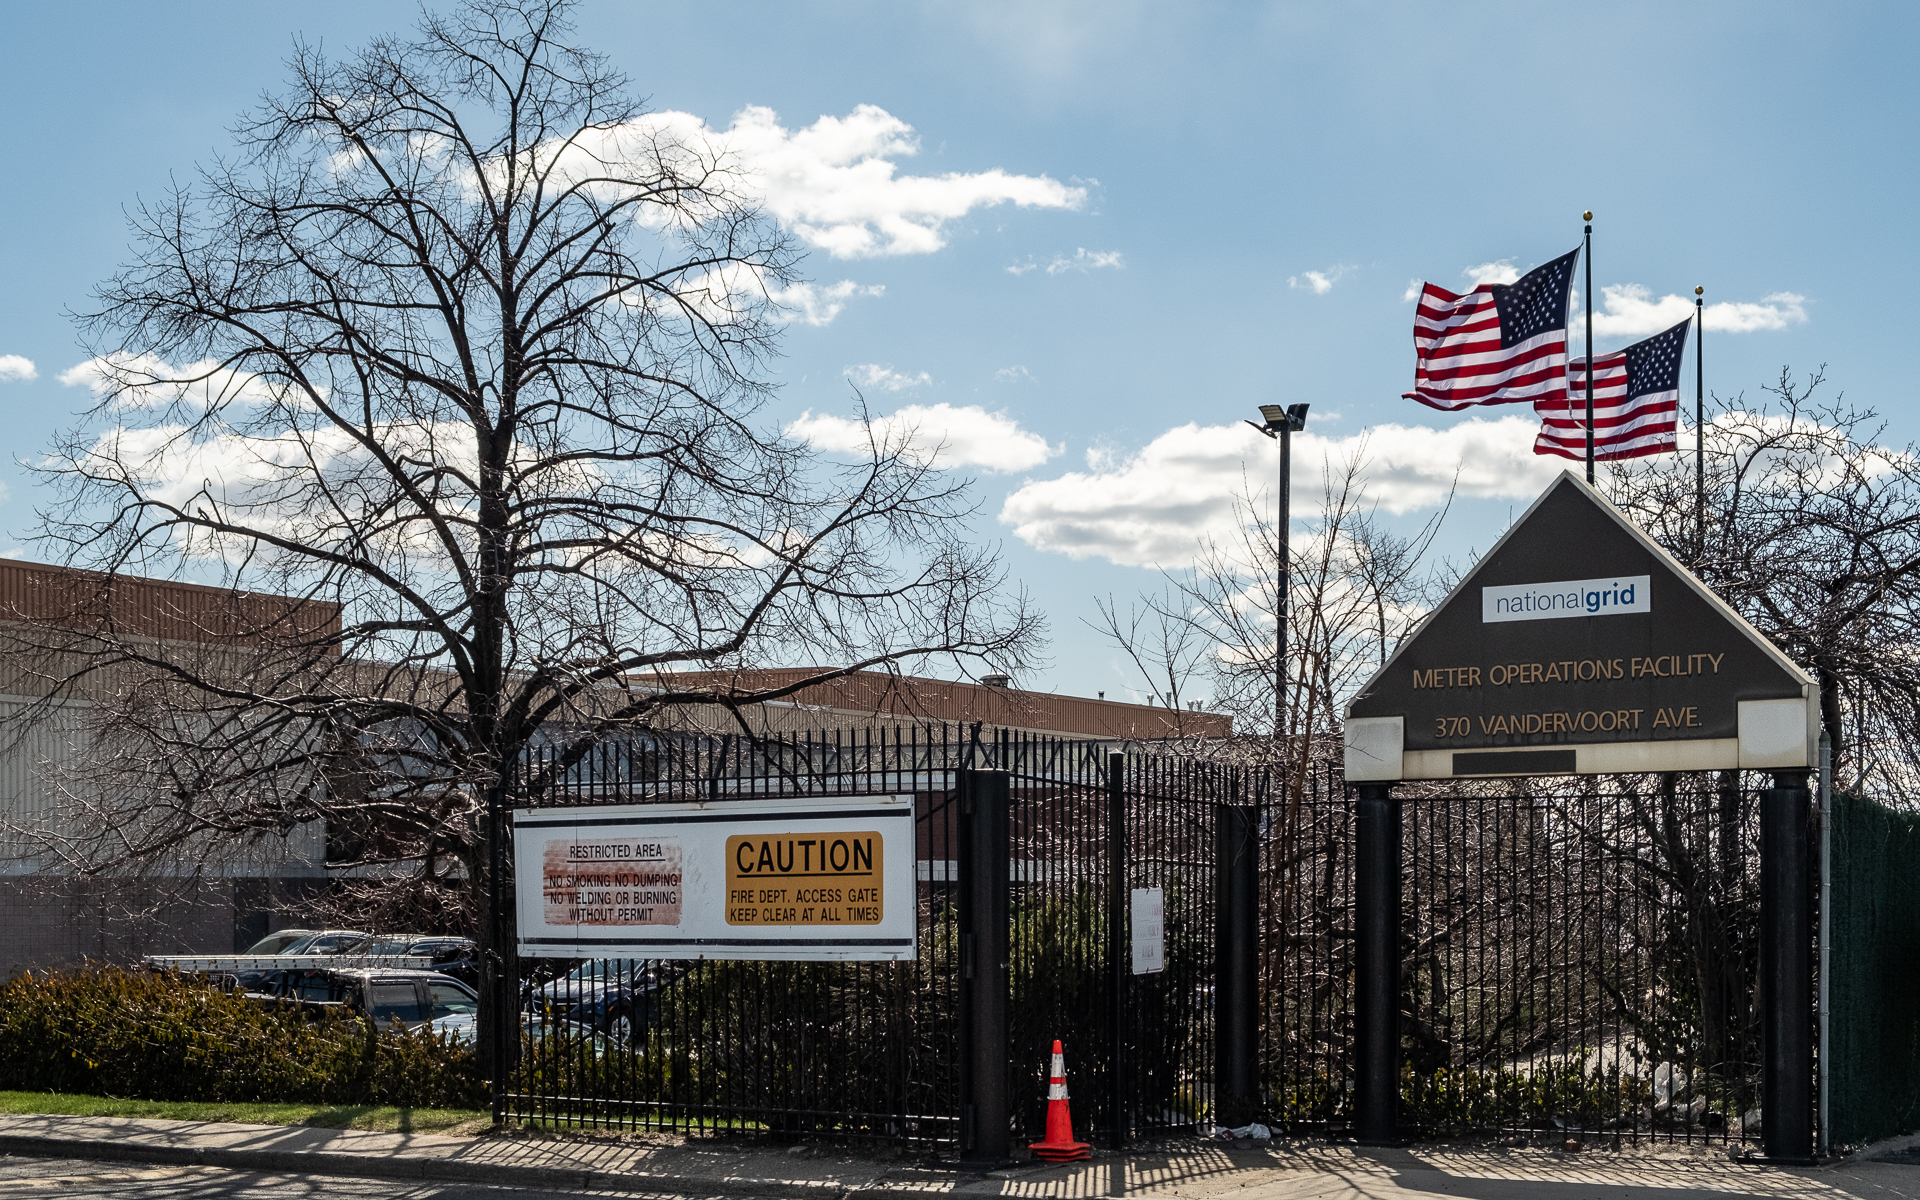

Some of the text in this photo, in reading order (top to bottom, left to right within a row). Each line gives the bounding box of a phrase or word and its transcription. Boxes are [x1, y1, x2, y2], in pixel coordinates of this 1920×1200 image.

[1497, 581, 1635, 613] nationalgrid
[1413, 652, 1725, 690] METER OPERATIONS FACILITY
[1434, 706, 1703, 739] 370 VANDERVOORT AVE.
[569, 843, 663, 859] RESTRICTED AREA
[736, 838, 873, 873] CAUTION
[549, 873, 678, 888] NO SMOKING NO DUMPING
[550, 891, 677, 905] NO WELDING OR BURNING
[730, 888, 879, 904] FIRE DEPT. ACCESS GATE
[568, 908, 654, 921] WITHOUT PERMIT
[730, 907, 879, 922] KEEP CLEAR AT ALL TIMES
